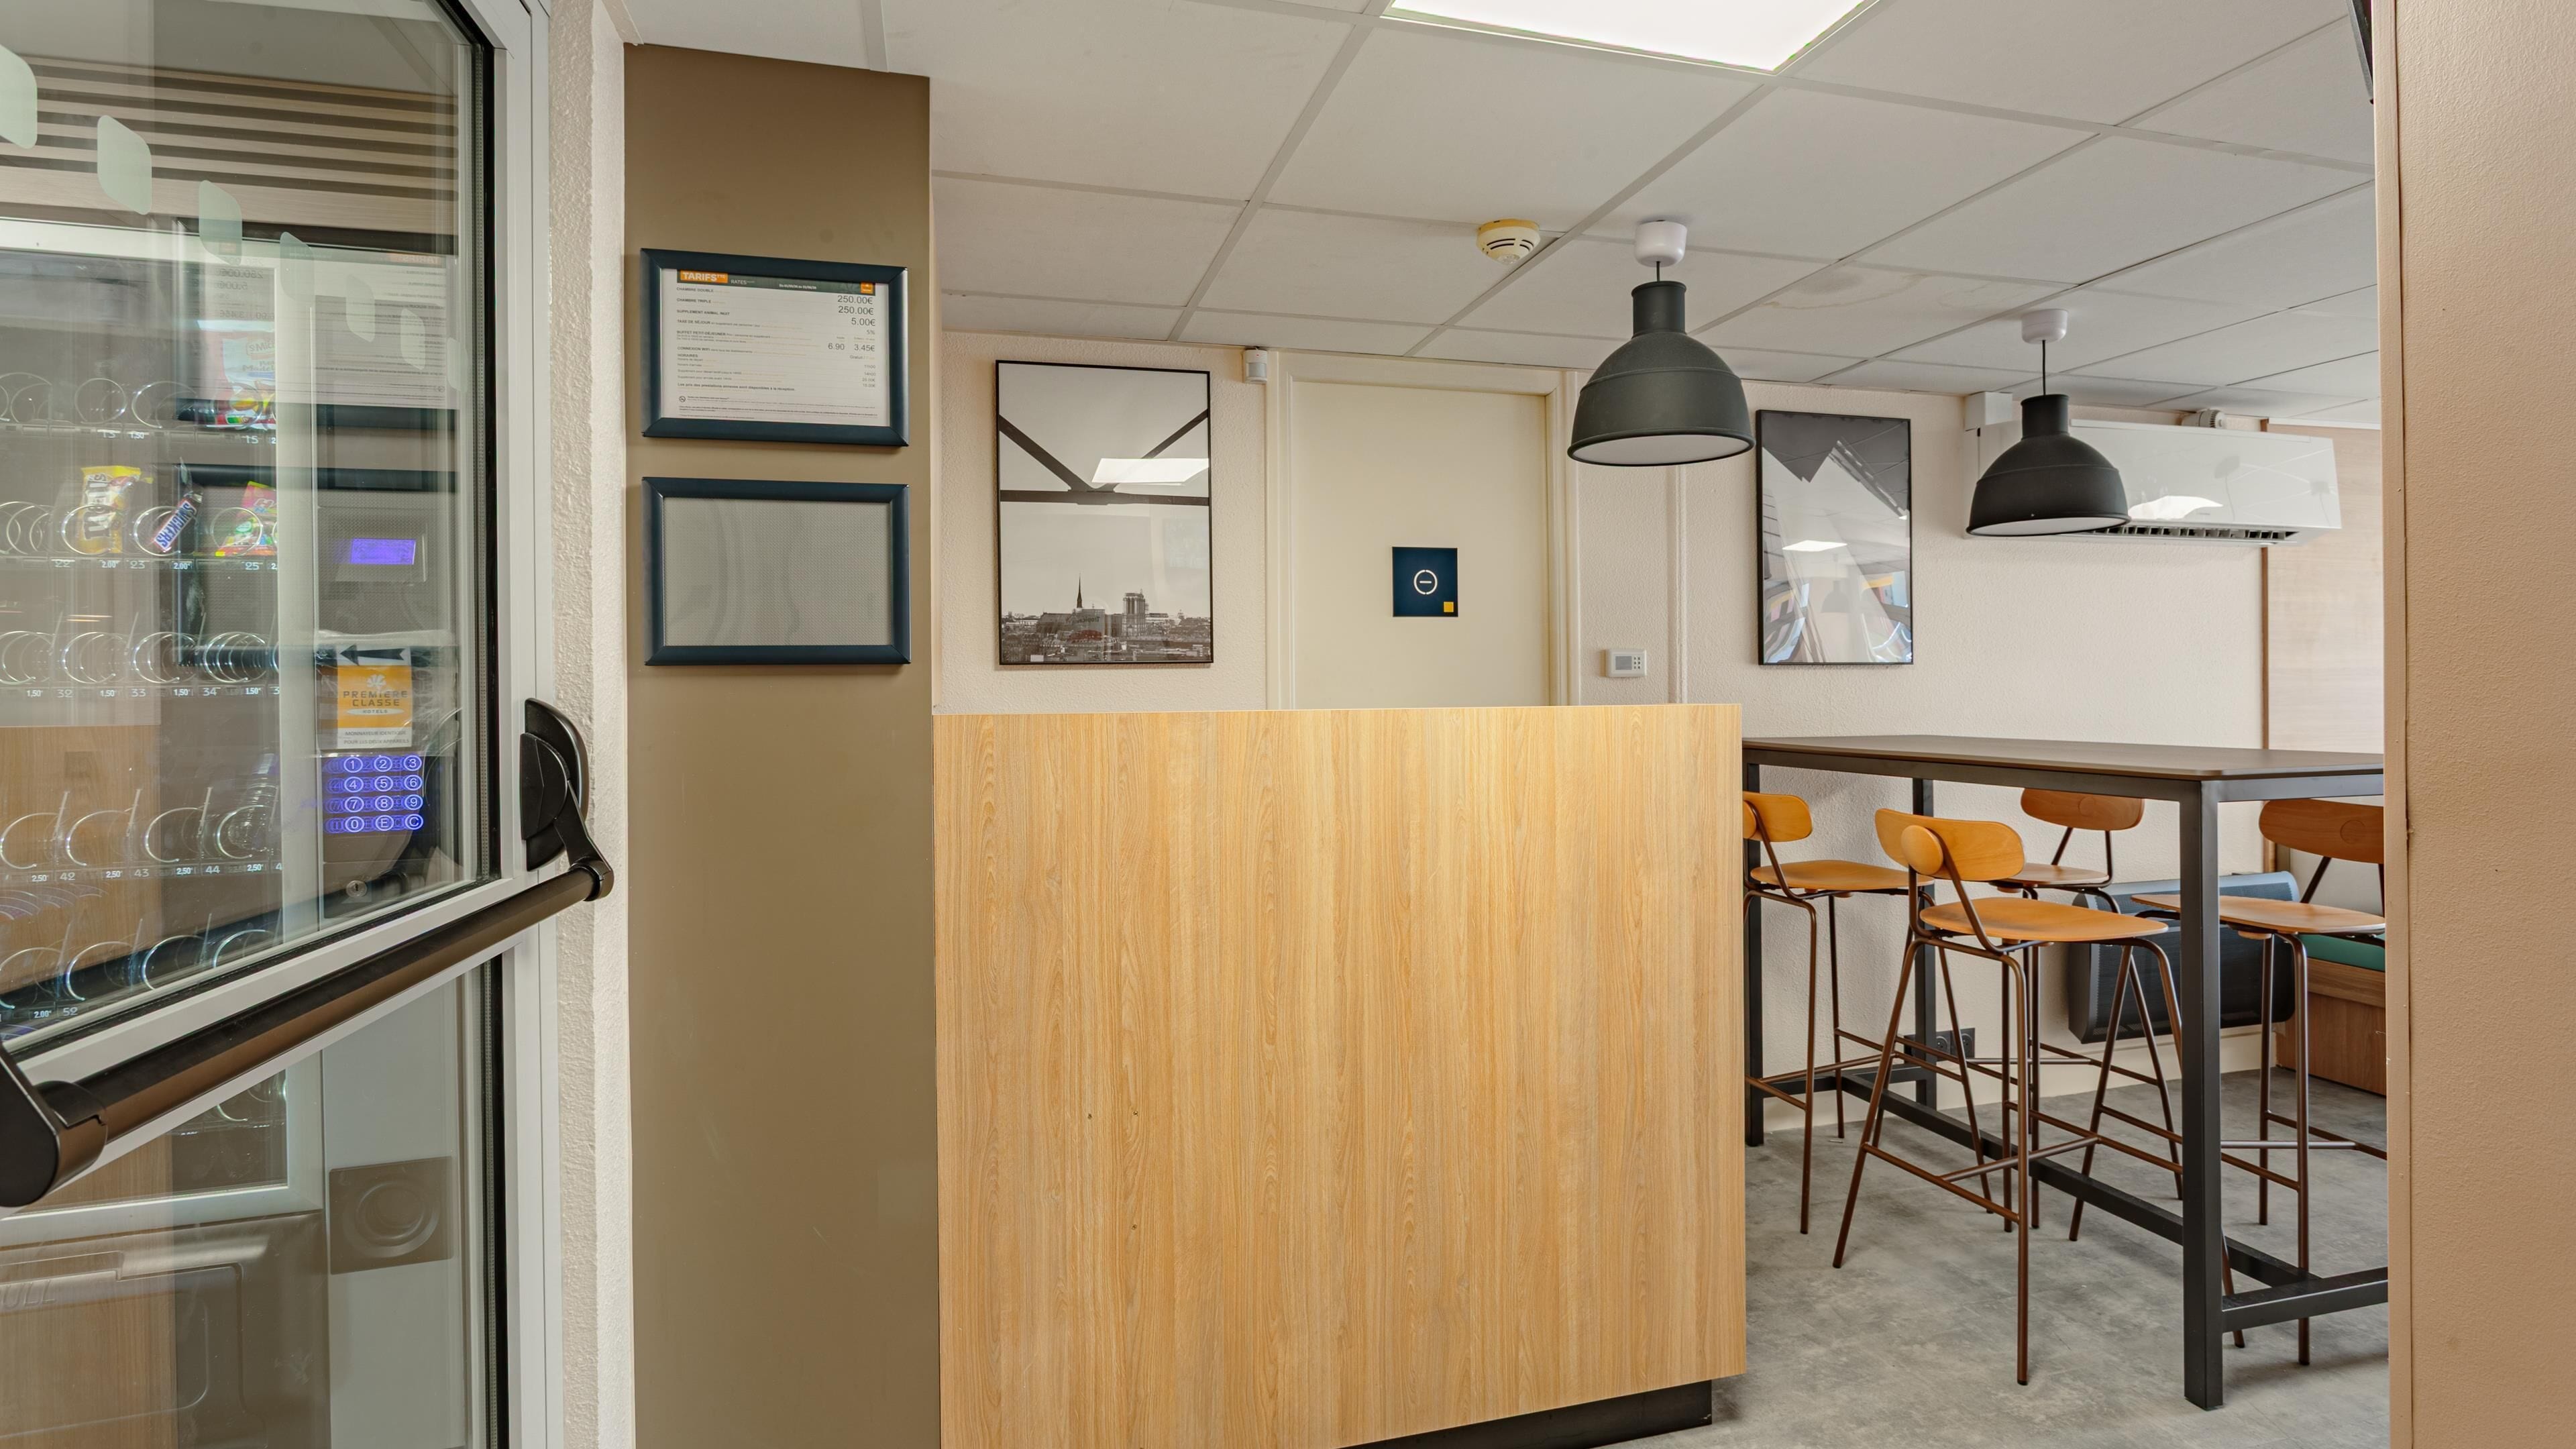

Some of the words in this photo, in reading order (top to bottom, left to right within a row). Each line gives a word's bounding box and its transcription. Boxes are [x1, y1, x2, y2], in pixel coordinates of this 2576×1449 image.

[682, 272, 717, 282] TARIFS
[837, 295, 873, 305] 250.00€
[838, 306, 873, 315] 250.00€
[851, 317, 875, 327] 5.00€
[854, 344, 875, 352] 3.45€
[155, 502, 196, 549] SNICKERS
[245, 562, 260, 570] 25
[131, 688, 146, 697] 33
[203, 688, 217, 696] 34
[60, 872, 75, 881] 42
[134, 869, 150, 877] 43
[205, 865, 221, 874] 44
[62, 1006, 78, 1016] 52
